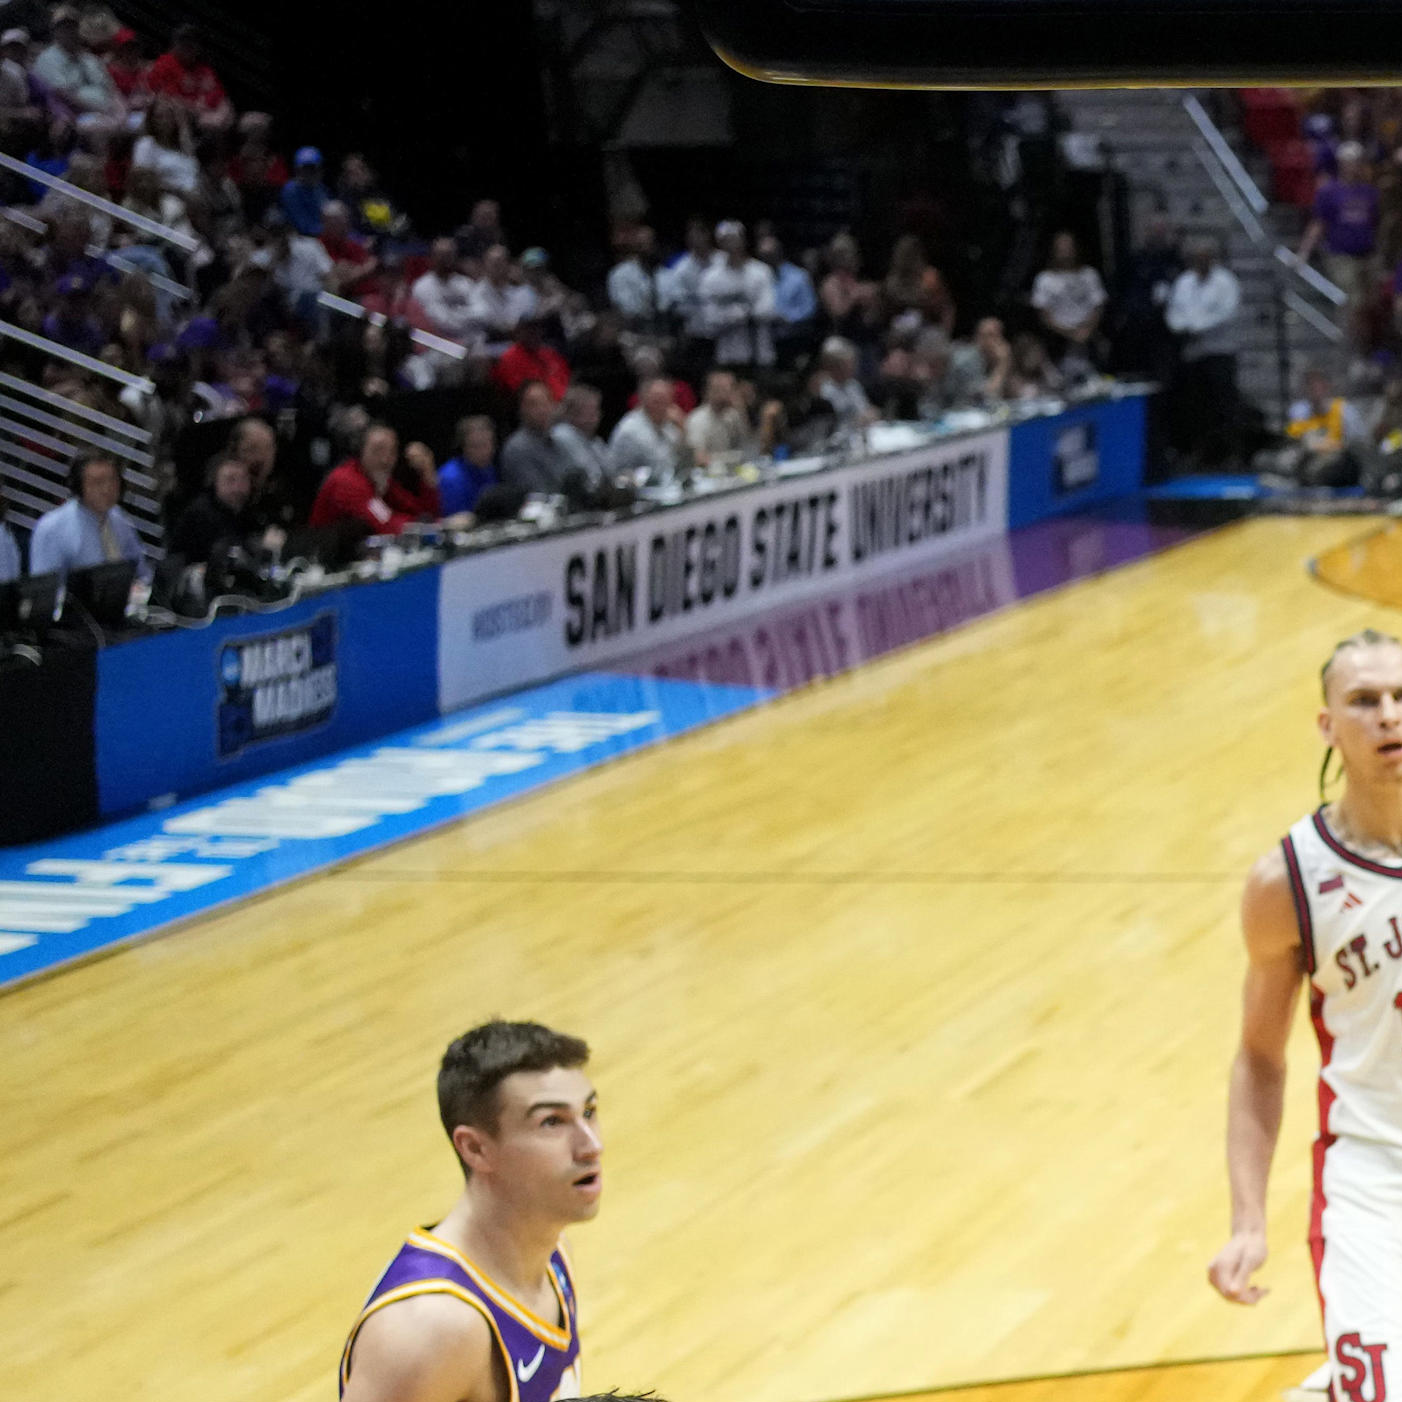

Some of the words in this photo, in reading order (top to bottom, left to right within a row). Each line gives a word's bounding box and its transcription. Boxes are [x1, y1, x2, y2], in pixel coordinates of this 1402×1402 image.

[564, 539, 637, 648] SAN
[648, 515, 742, 626] DIEGO
[750, 491, 838, 590] STATE
[850, 450, 989, 562] UNIVERSITY
[242, 632, 313, 688] MARCH
[253, 664, 337, 729] MADNESS
[1336, 933, 1380, 990] ST.
